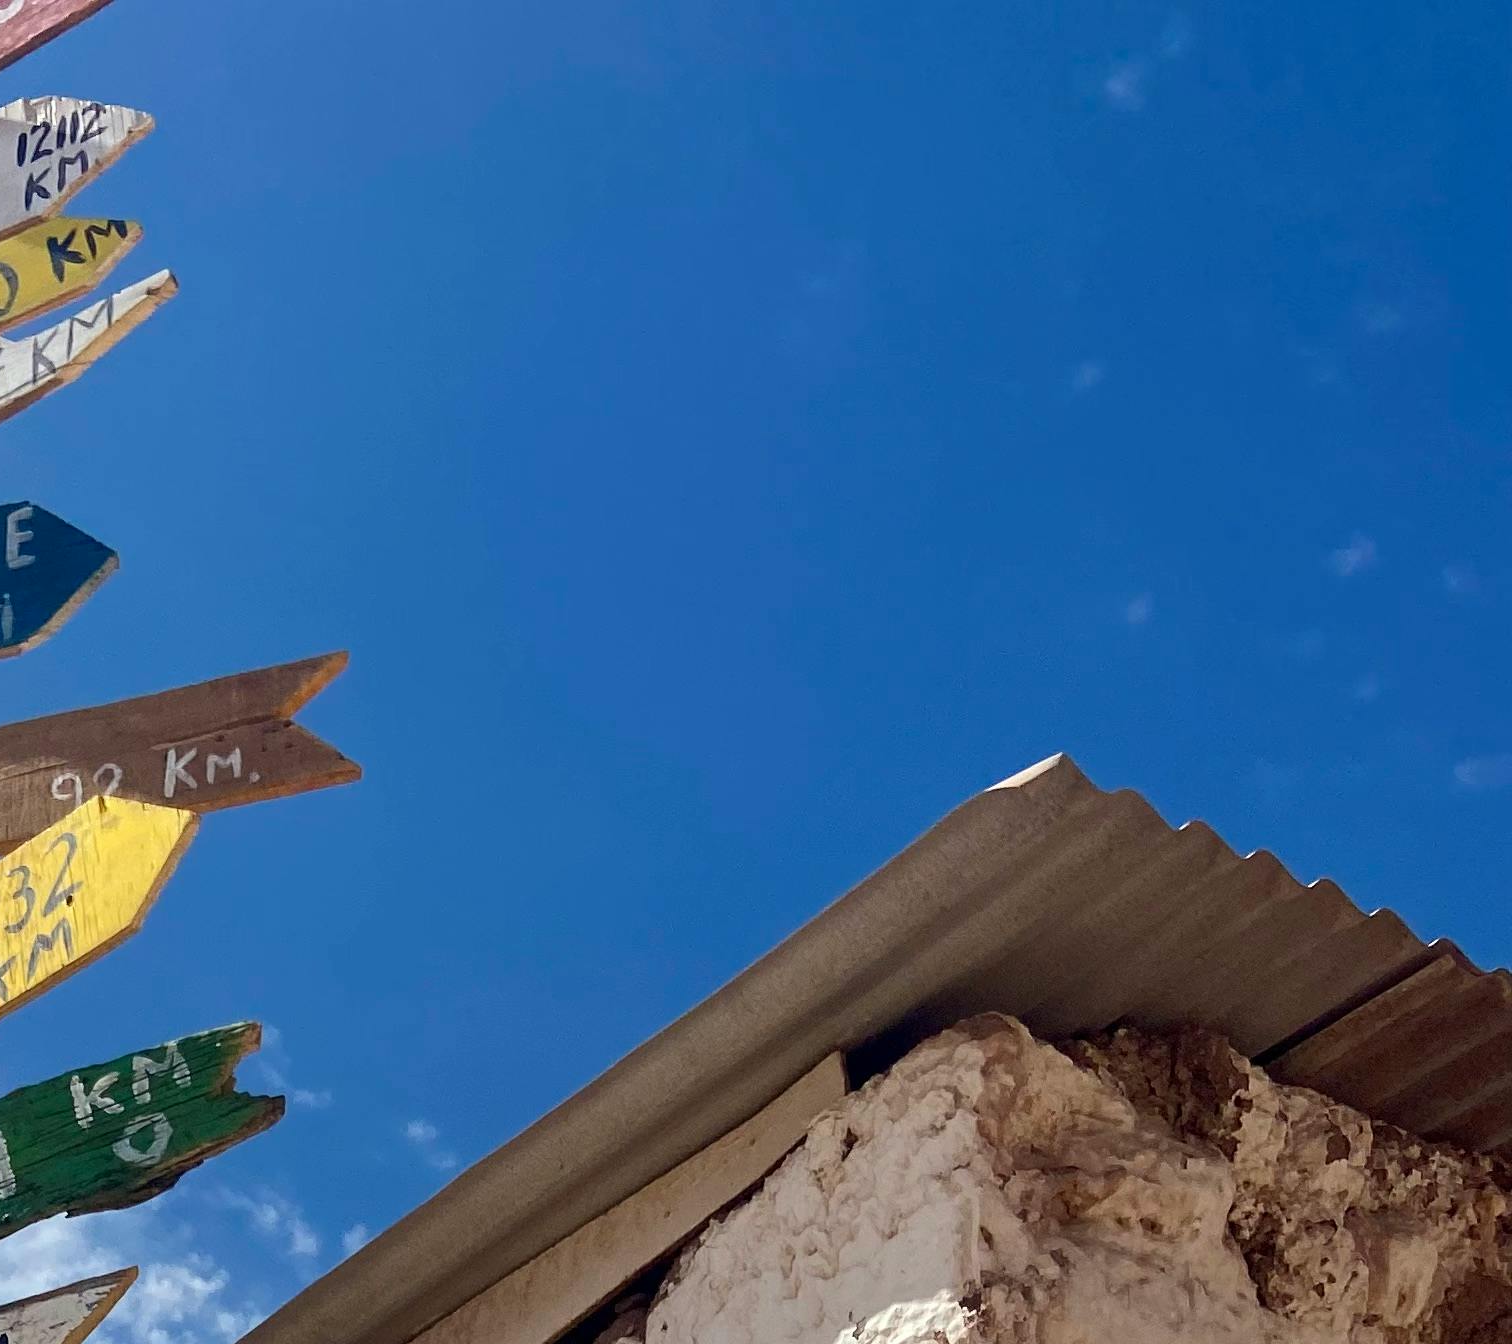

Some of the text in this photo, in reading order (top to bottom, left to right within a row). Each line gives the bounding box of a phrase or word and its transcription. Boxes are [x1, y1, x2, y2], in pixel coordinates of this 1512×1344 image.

[24, 150, 89, 212] KM
[46, 219, 130, 284] KM
[31, 295, 114, 386] KM
[69, 1039, 192, 1130] KM
